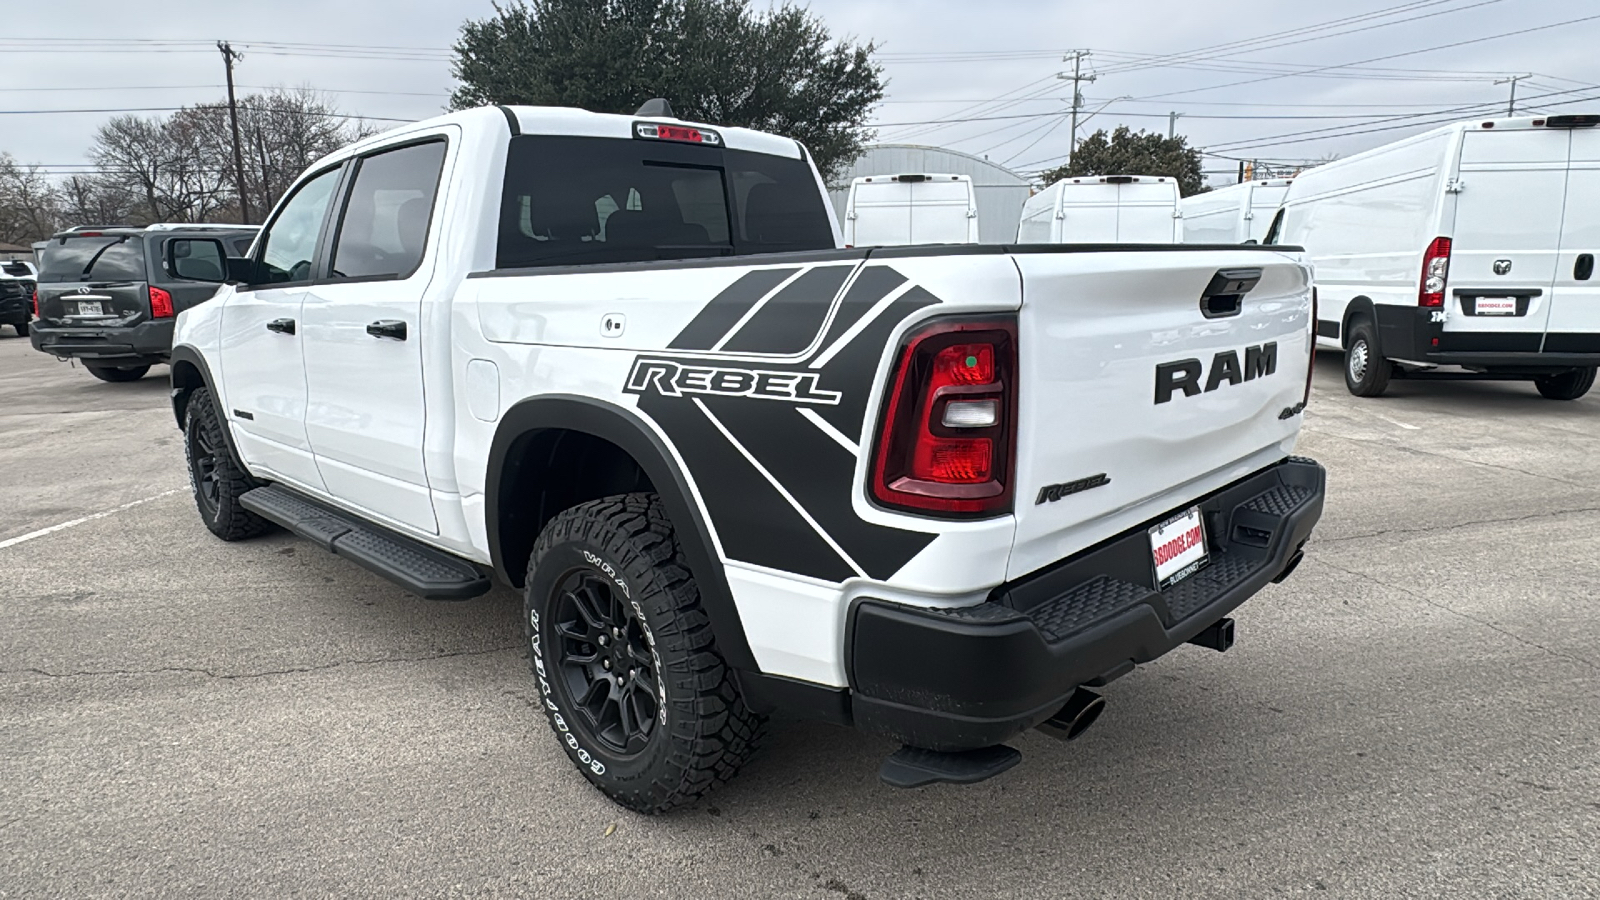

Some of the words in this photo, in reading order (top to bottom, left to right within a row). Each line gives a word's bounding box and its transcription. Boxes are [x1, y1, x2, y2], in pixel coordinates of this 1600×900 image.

[627, 358, 843, 406] REBEL
[1154, 341, 1278, 405] RAM
[1034, 472, 1112, 506] REBEL
[530, 608, 606, 776] GOODYEAR
